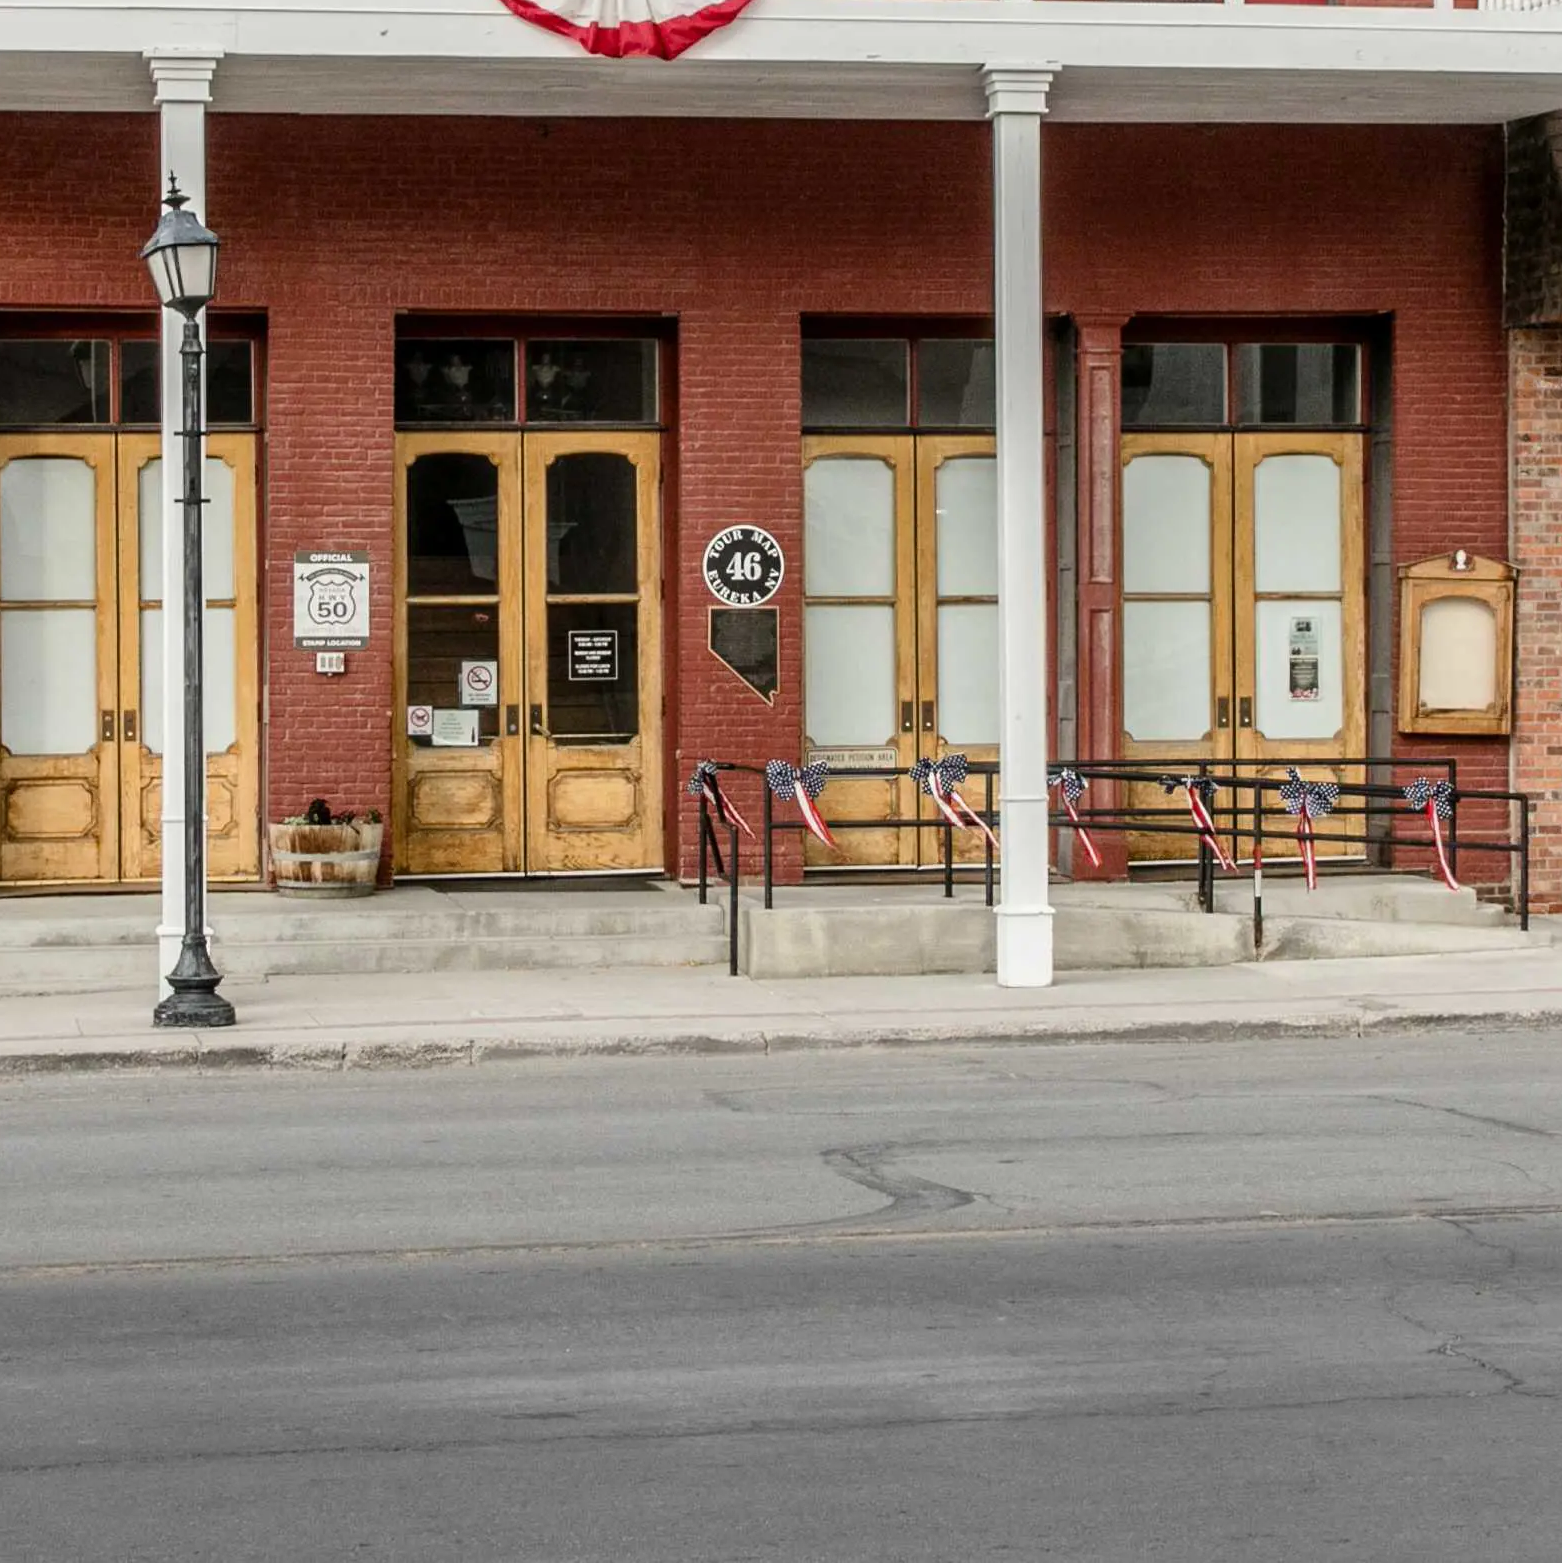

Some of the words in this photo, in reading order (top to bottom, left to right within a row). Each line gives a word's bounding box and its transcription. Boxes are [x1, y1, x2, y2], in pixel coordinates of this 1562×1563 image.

[708, 529, 743, 559] TOUR
[751, 531, 778, 558] MAP
[309, 553, 353, 563] OFFICIAL
[725, 551, 762, 581] 46
[708, 569, 762, 604] EUREKA
[764, 568, 779, 589] NV
[317, 601, 348, 618] 50
[302, 639, 326, 647] STAMP
[326, 639, 362, 647] LOCATION
